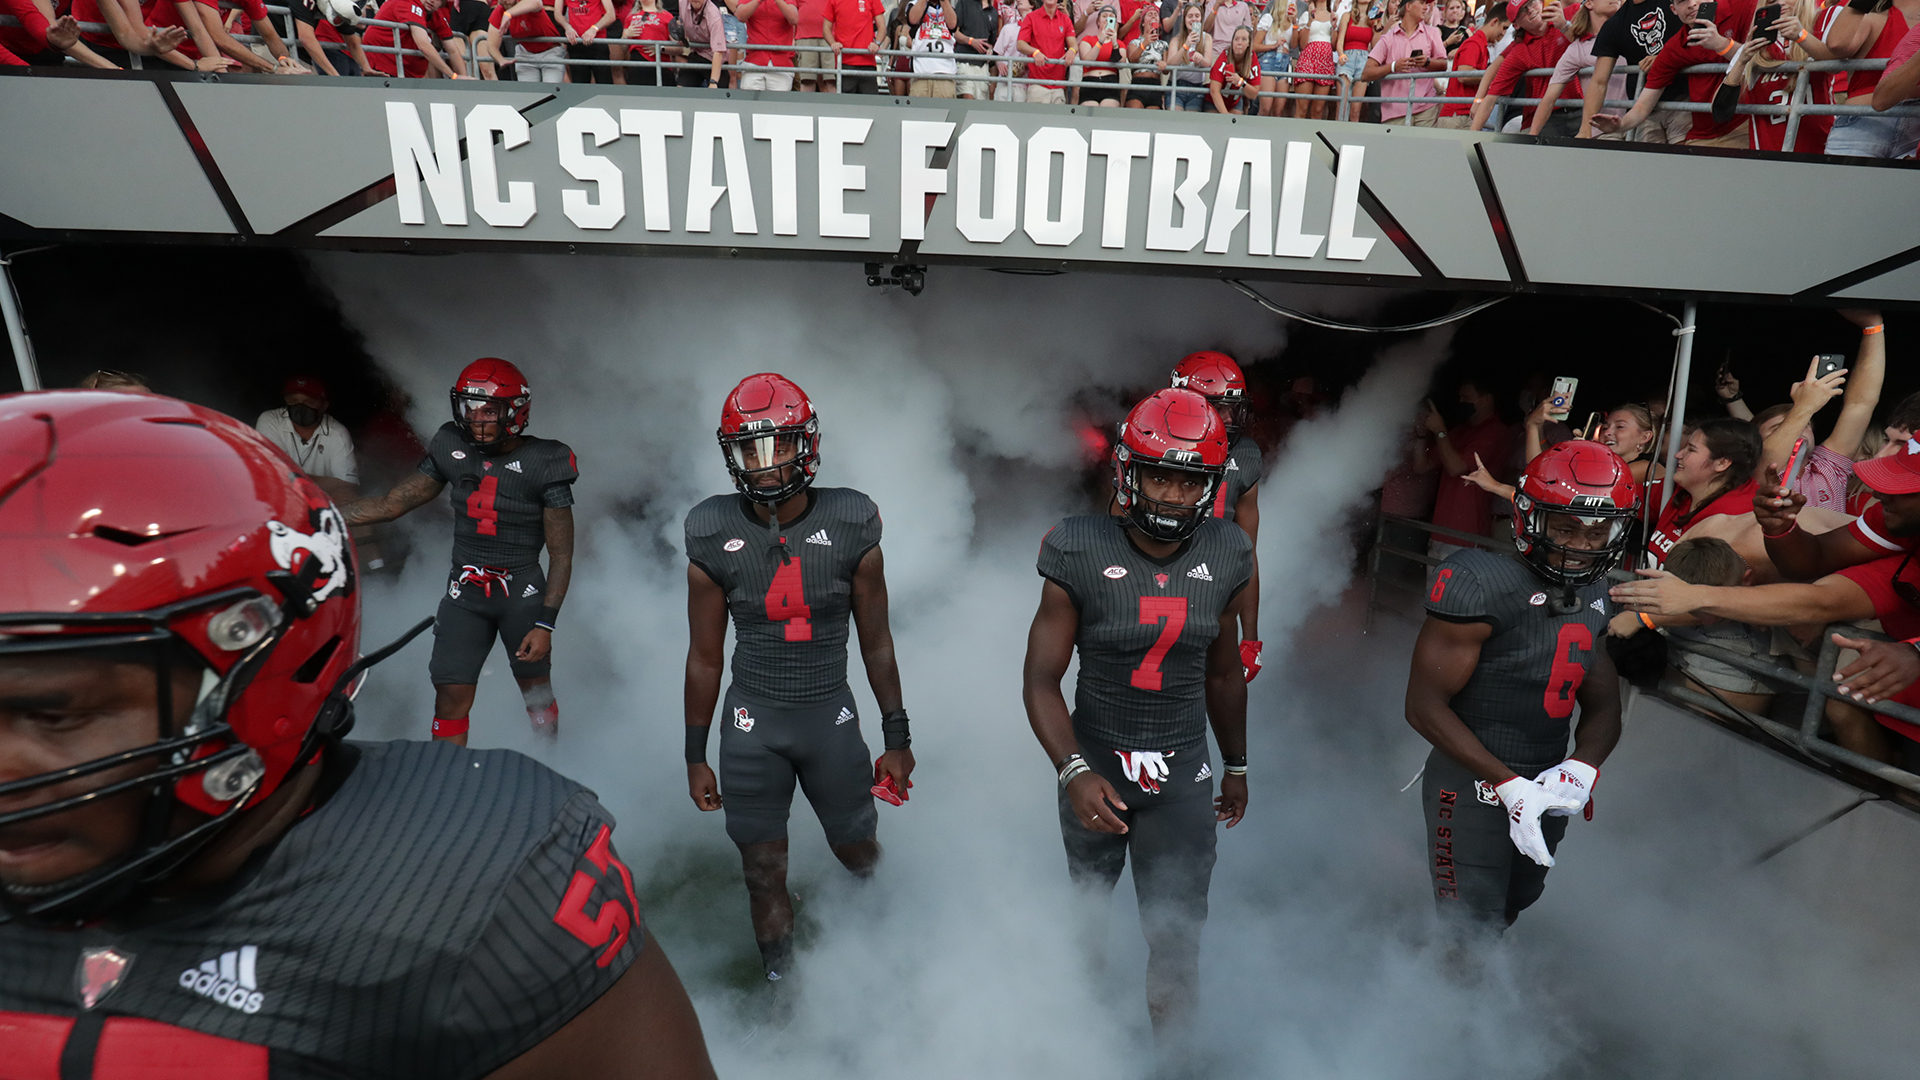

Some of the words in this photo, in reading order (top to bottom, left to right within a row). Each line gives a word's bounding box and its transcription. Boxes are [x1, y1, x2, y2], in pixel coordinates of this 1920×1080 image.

[411, 4, 423, 17] 19
[1249, 65, 1259, 79] 17
[385, 101, 538, 228] NC
[556, 106, 876, 239] STATE
[900, 120, 1378, 261] FOOTBALL
[747, 420, 763, 431] HTT
[1175, 451, 1194, 462] HTT
[466, 475, 499, 536] 4
[1584, 496, 1605, 507] HTT
[726, 539, 743, 549] ACC
[806, 537, 832, 546] adidas
[1107, 568, 1124, 576] ACC
[1187, 571, 1213, 582] adidas
[1429, 568, 1453, 603] 6
[765, 556, 812, 641] 4
[1130, 596, 1188, 691] 7
[1543, 623, 1593, 719] 6
[835, 713, 855, 726] adidas
[1558, 767, 1585, 790] adidas
[1439, 789, 1458, 820] NC
[1435, 826, 1459, 900] STATE
[178, 967, 265, 1014] adidas
